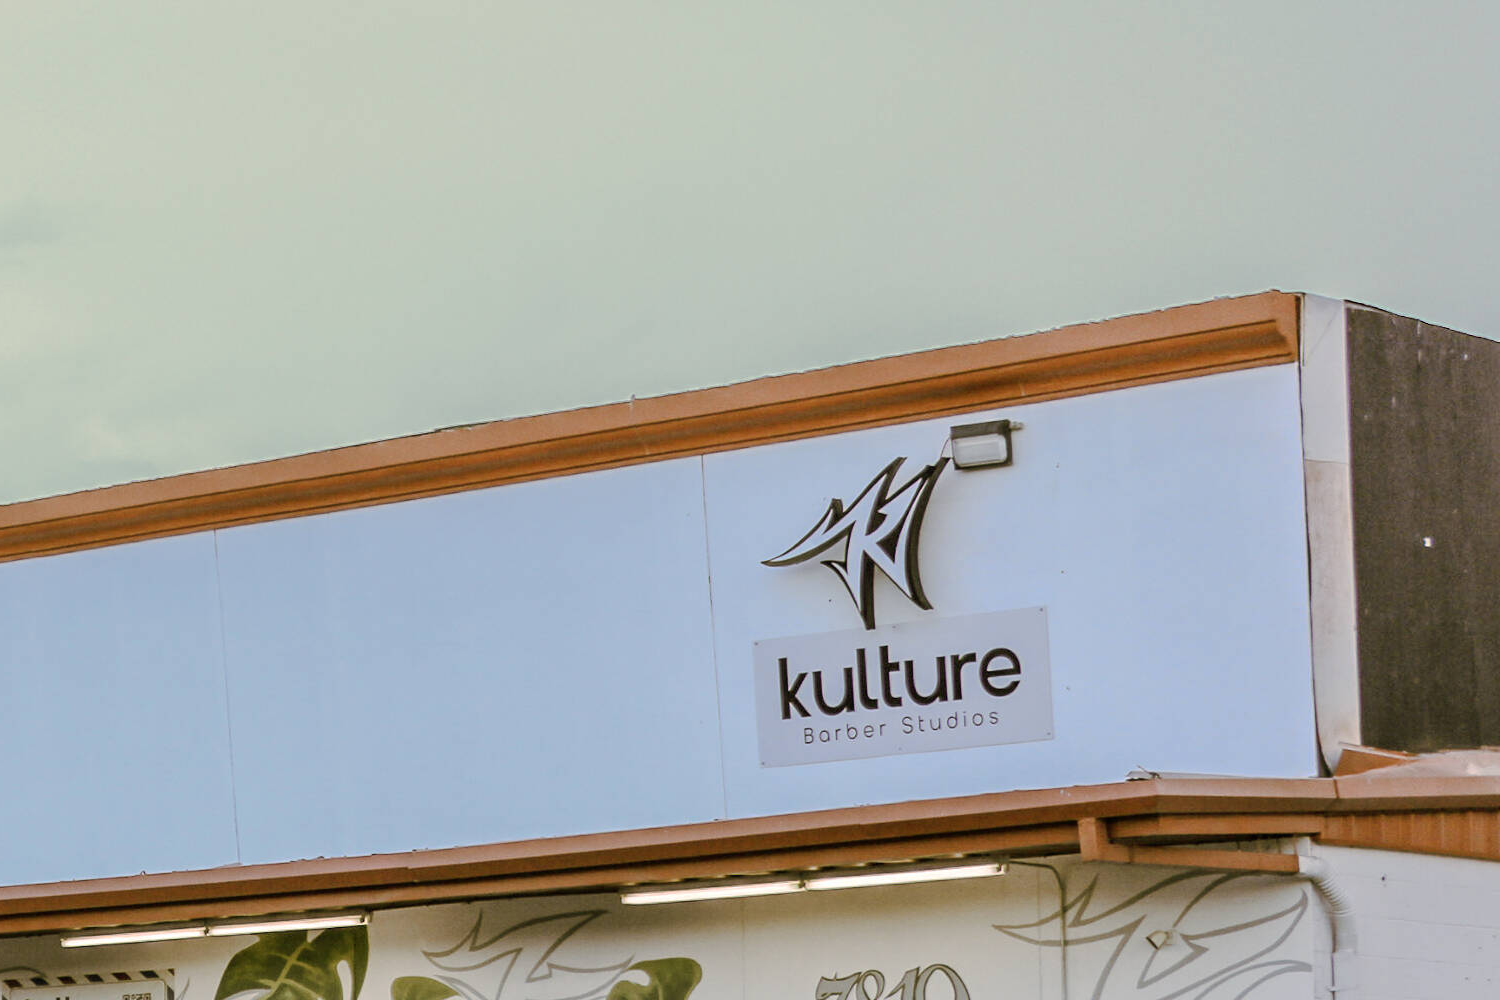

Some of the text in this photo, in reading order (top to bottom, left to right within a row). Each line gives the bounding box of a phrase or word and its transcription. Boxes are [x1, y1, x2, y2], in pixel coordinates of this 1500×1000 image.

[777, 645, 1021, 720] kulture
[803, 709, 1001, 744] Barber Studios
